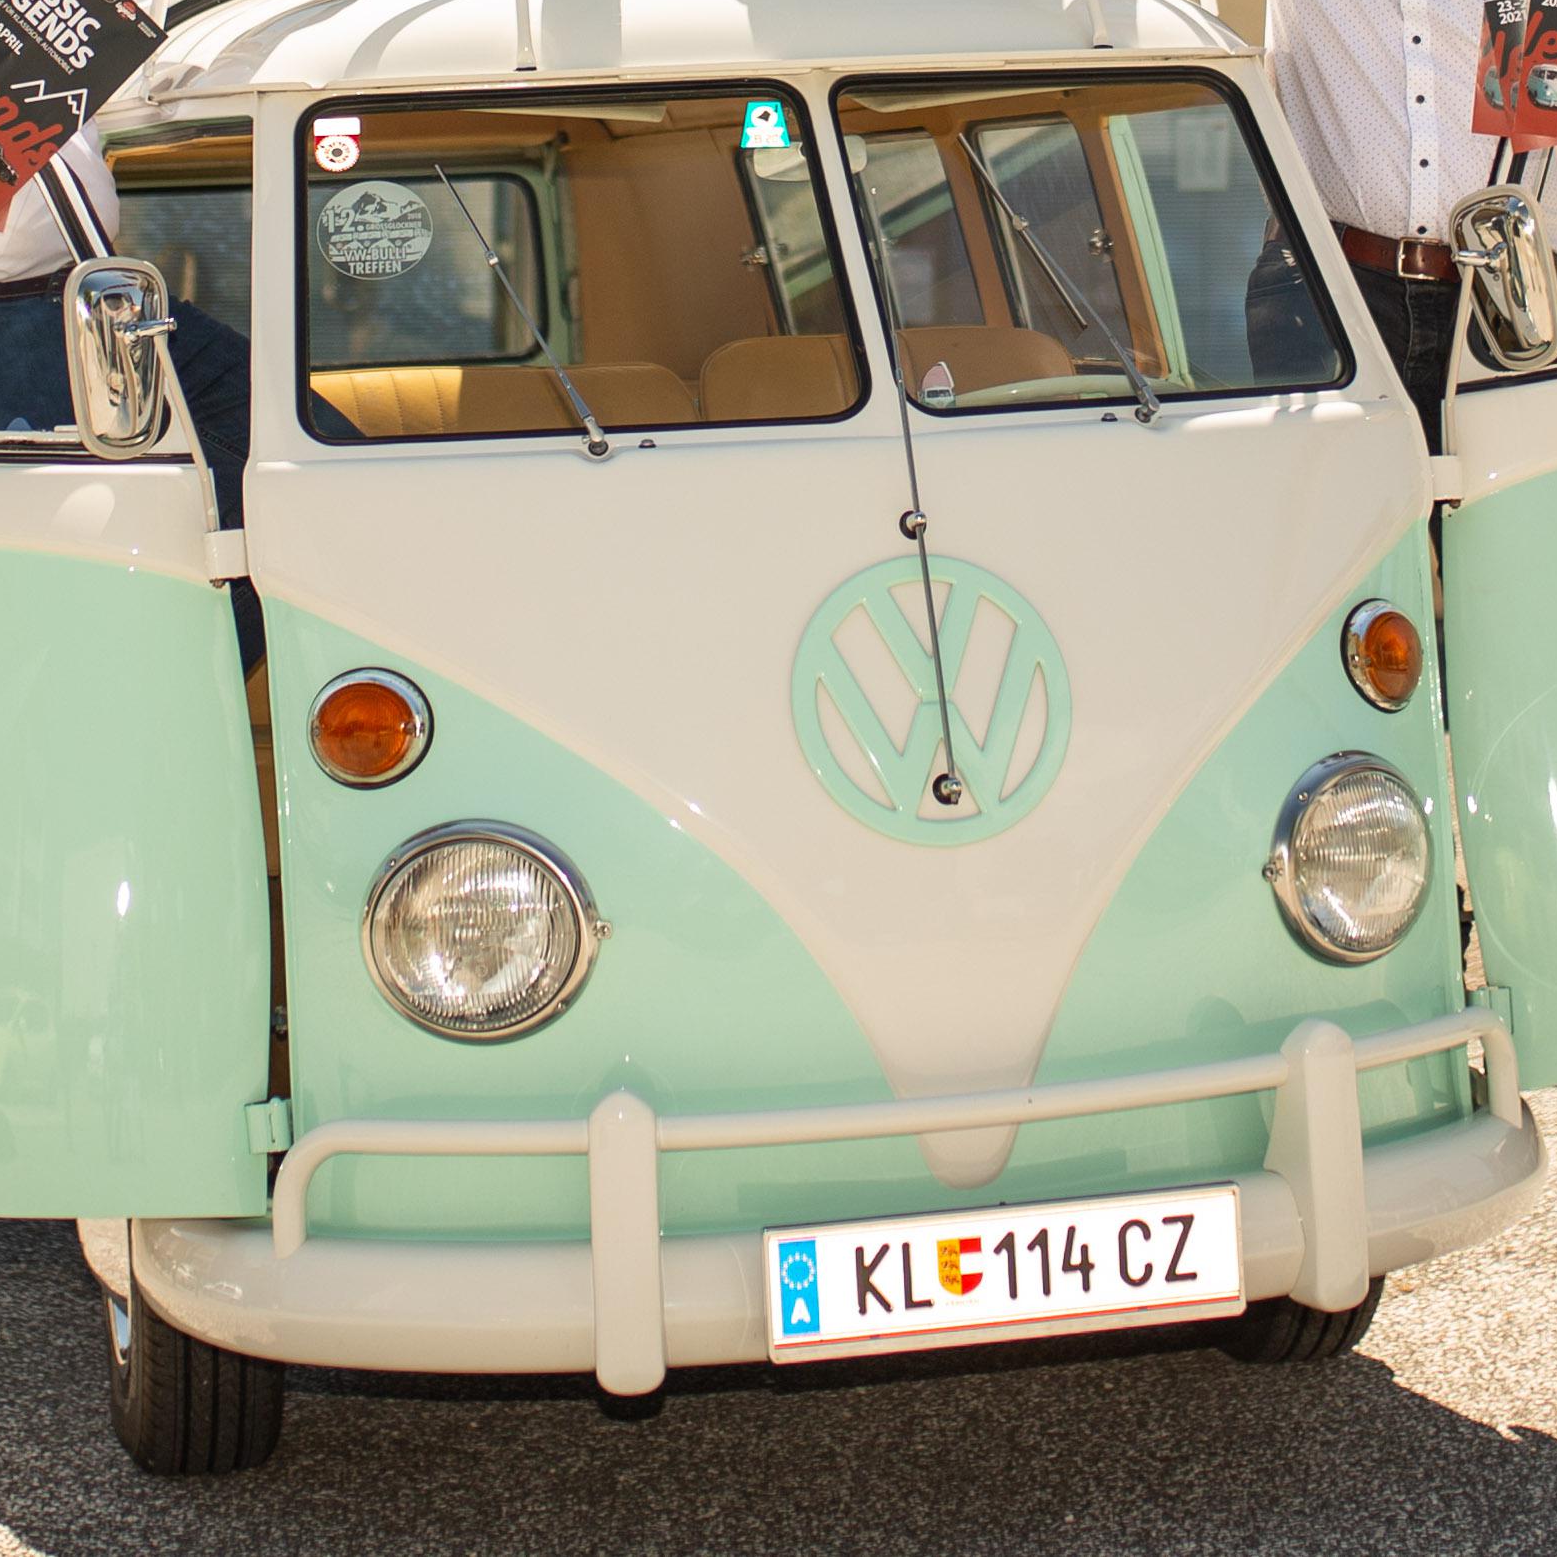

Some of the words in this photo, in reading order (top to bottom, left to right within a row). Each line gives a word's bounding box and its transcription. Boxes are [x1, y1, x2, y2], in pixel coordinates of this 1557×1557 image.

[348, 261, 401, 275] TREFFEN
[790, 554, 1073, 848] VW
[855, 1243, 935, 1315] KL
[993, 1225, 1095, 1299] 114
[1118, 1214, 1198, 1287] CZ
[790, 1297, 812, 1325] A
